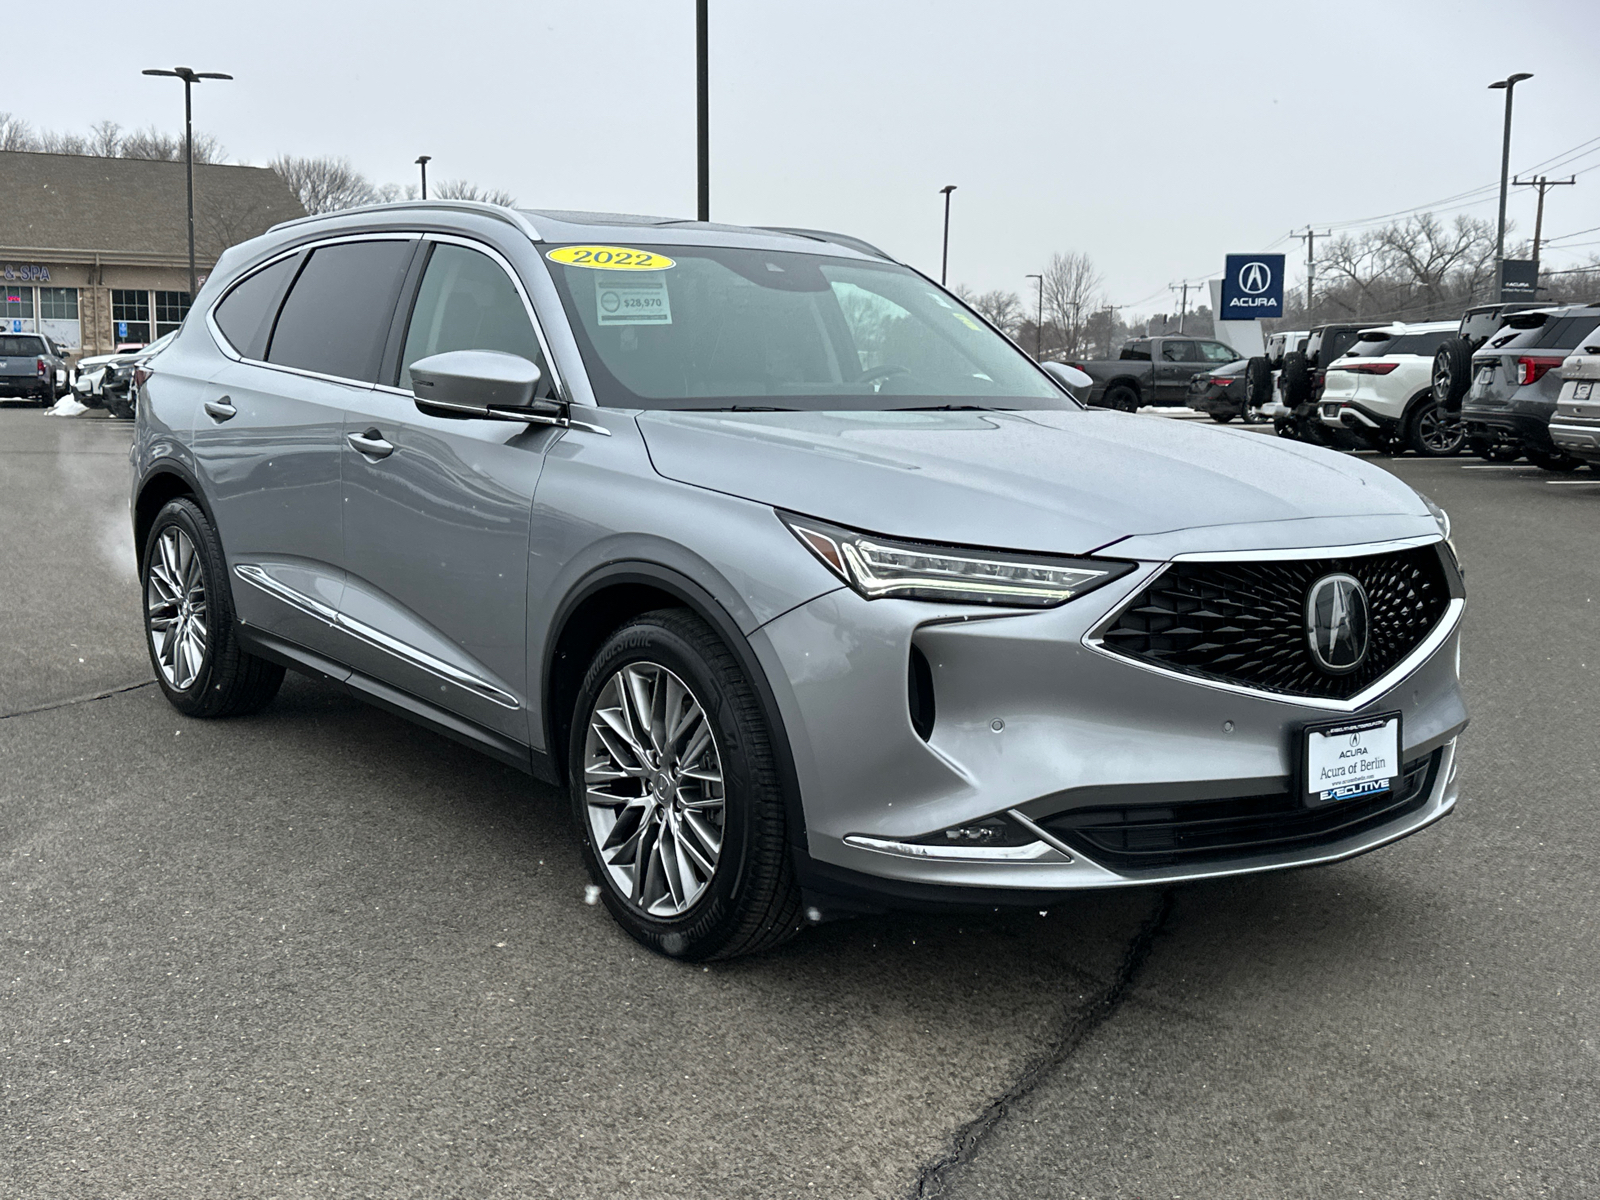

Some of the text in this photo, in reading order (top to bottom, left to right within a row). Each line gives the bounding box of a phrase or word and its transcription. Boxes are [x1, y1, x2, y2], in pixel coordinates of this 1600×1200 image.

[572, 250, 653, 267] 2022
[4, 264, 51, 282] & SPA
[623, 298, 662, 309] $28,970
[1229, 297, 1278, 307] ACURA
[1339, 747, 1369, 759] ACURA
[1320, 757, 1386, 780] Acura of Berlin
[1320, 778, 1390, 801] EXECUTIVE
